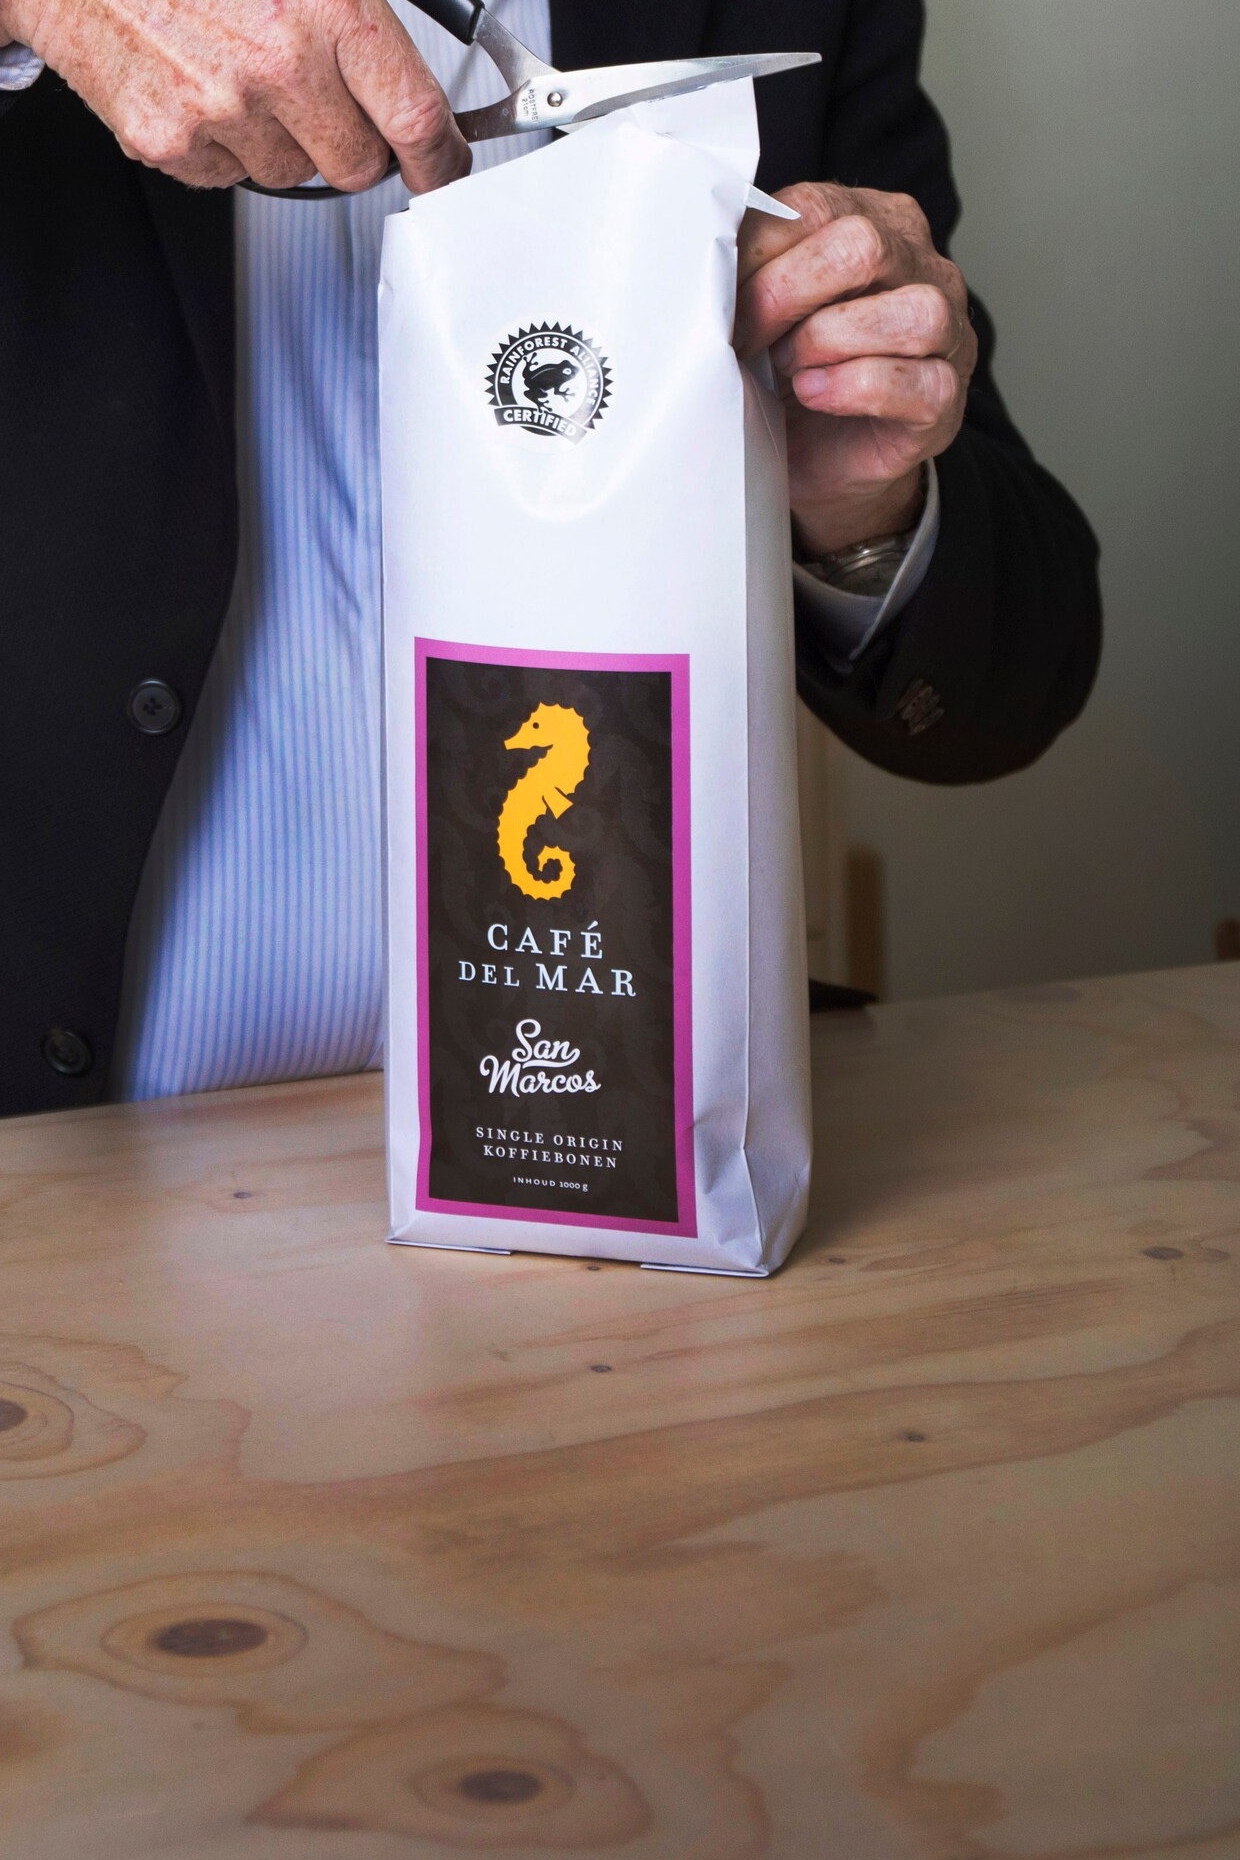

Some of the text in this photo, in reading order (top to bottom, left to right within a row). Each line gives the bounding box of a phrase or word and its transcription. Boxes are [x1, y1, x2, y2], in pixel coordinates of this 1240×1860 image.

[500, 336, 599, 406] RAINFOREST ALLIANCE
[503, 409, 577, 437] CERTIFIED
[487, 920, 603, 959] CAFÉ
[458, 960, 637, 997] DEL MAR
[511, 1018, 581, 1069] San
[479, 1055, 602, 1097] Marcos
[476, 1126, 623, 1151] SINGLE ORIGIN
[483, 1145, 617, 1168] KOFFIEBONEN
[513, 1176, 589, 1192] INHOUD 1000 g
